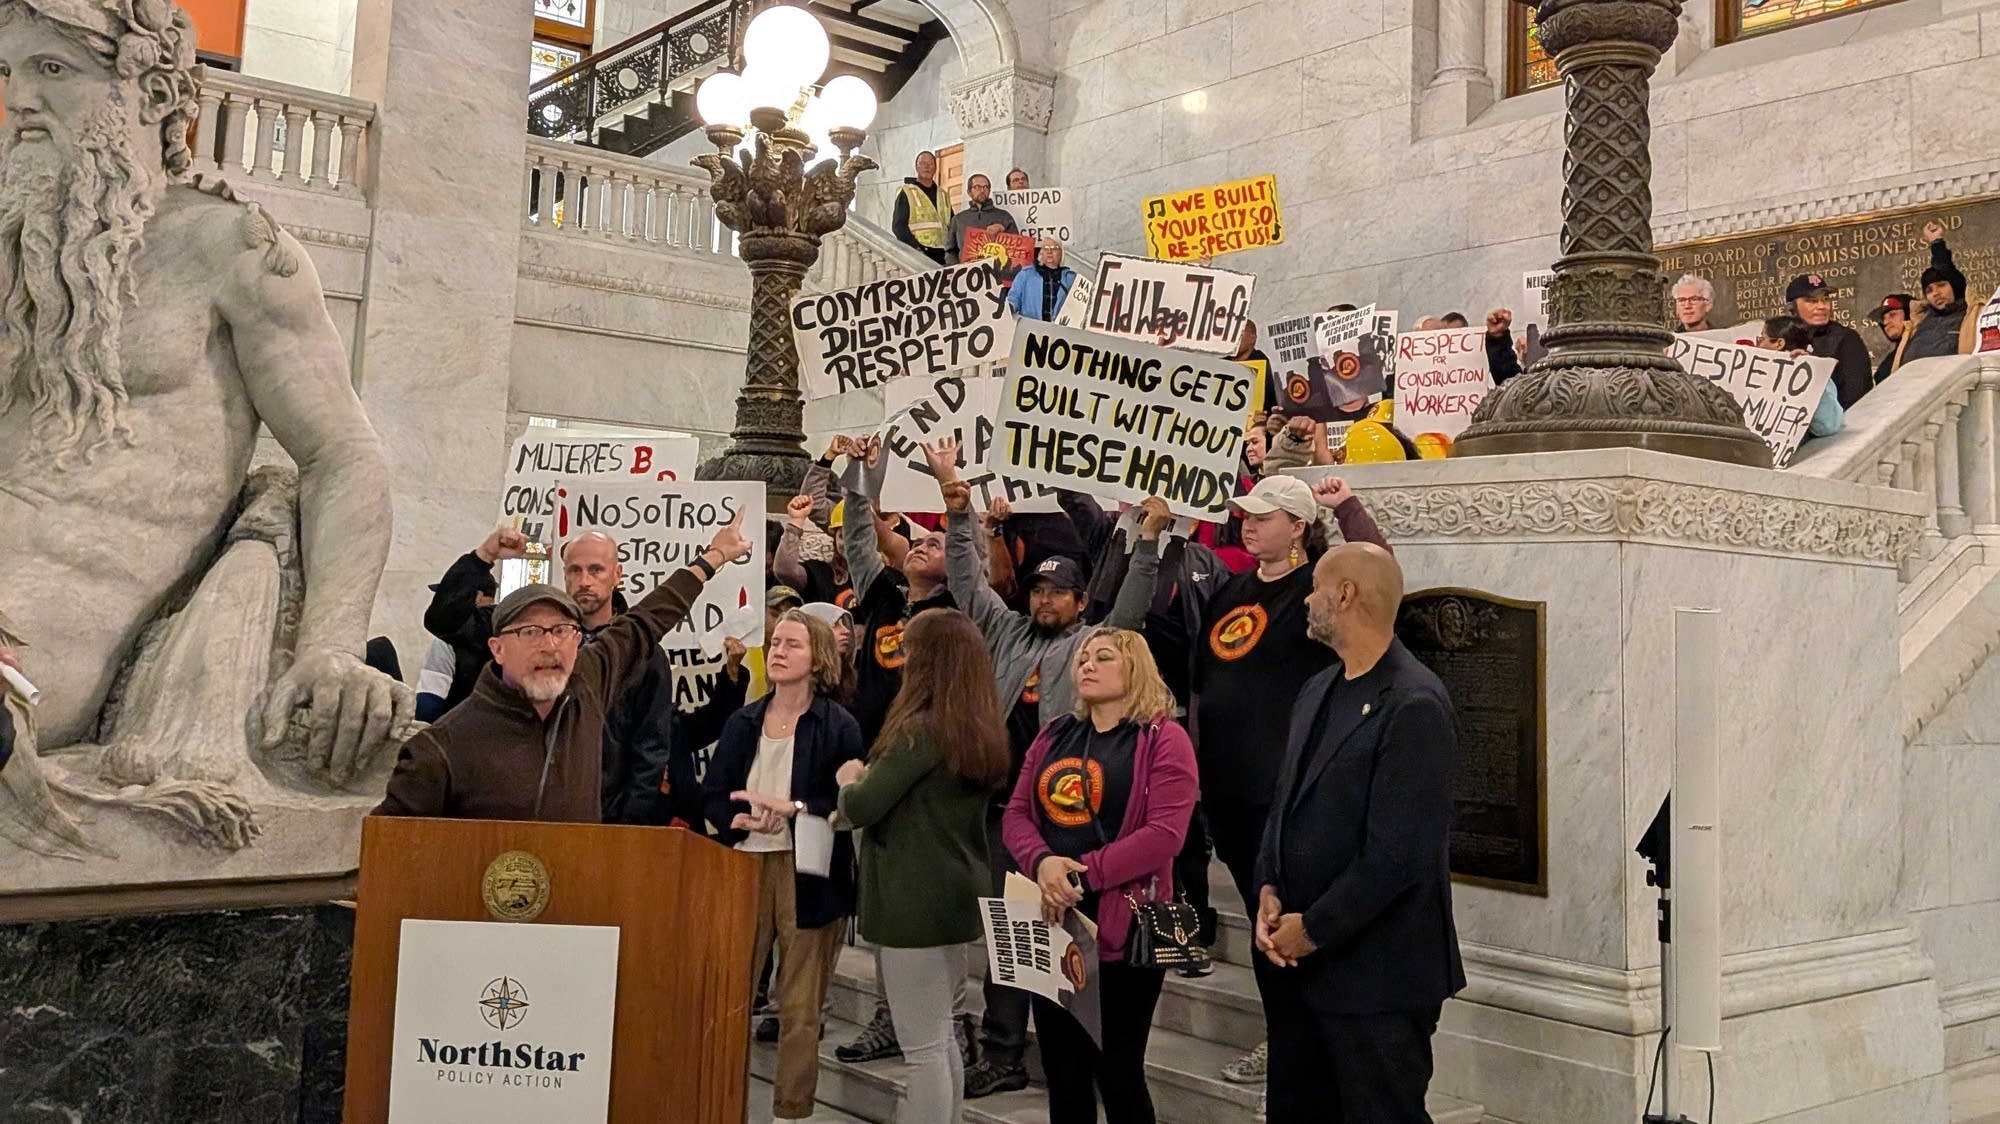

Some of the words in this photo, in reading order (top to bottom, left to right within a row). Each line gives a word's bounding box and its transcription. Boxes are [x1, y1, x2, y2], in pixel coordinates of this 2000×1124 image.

[994, 190, 1062, 206] DIGNIDAD
[1171, 193, 1206, 213] WE
[1213, 181, 1267, 209] BUILT
[1026, 206, 1038, 224] &
[1157, 215, 1211, 240] YOUR
[1212, 208, 1247, 231] CITY
[1249, 206, 1273, 226] SO
[1167, 231, 1242, 259] RE-SPECT
[1245, 227, 1271, 246] US!
[1660, 256, 1685, 272] THE
[1693, 247, 1745, 268] BOARD
[1754, 242, 1777, 258] OF
[1693, 265, 1716, 280] ITY
[1726, 261, 1767, 278] HALL
[1776, 237, 1930, 269] COMMISSIONERS
[985, 287, 1006, 320] Y
[1186, 274, 1248, 343] Theft
[1736, 286, 1780, 301] ROBERT
[1268, 315, 1311, 337] MINNEAPOLIS
[1273, 331, 1308, 350] RESIDENTS
[825, 325, 995, 394] RESPETO
[1399, 332, 1486, 361] RESPECT
[1432, 355, 1447, 365] FOR
[1023, 332, 1163, 393] NOTHING
[1168, 364, 1250, 412] GETS
[1016, 375, 1110, 425] BUILT
[1113, 398, 1243, 458] WITHOUT
[1404, 390, 1479, 416] WORKERS
[515, 442, 625, 475] MUJERES
[1004, 421, 1127, 484] THESE
[1124, 445, 1235, 514] HANDS
[1038, 560, 1061, 572] CAT
[987, 900, 1016, 983] NEIGHBORHOOD
[1012, 920, 1033, 968] BOARDS
[1035, 947, 1051, 974] FOR
[416, 1038, 586, 1072] NorthStar
[437, 1069, 495, 1085] POLICY
[502, 1073, 563, 1089] ACTION
